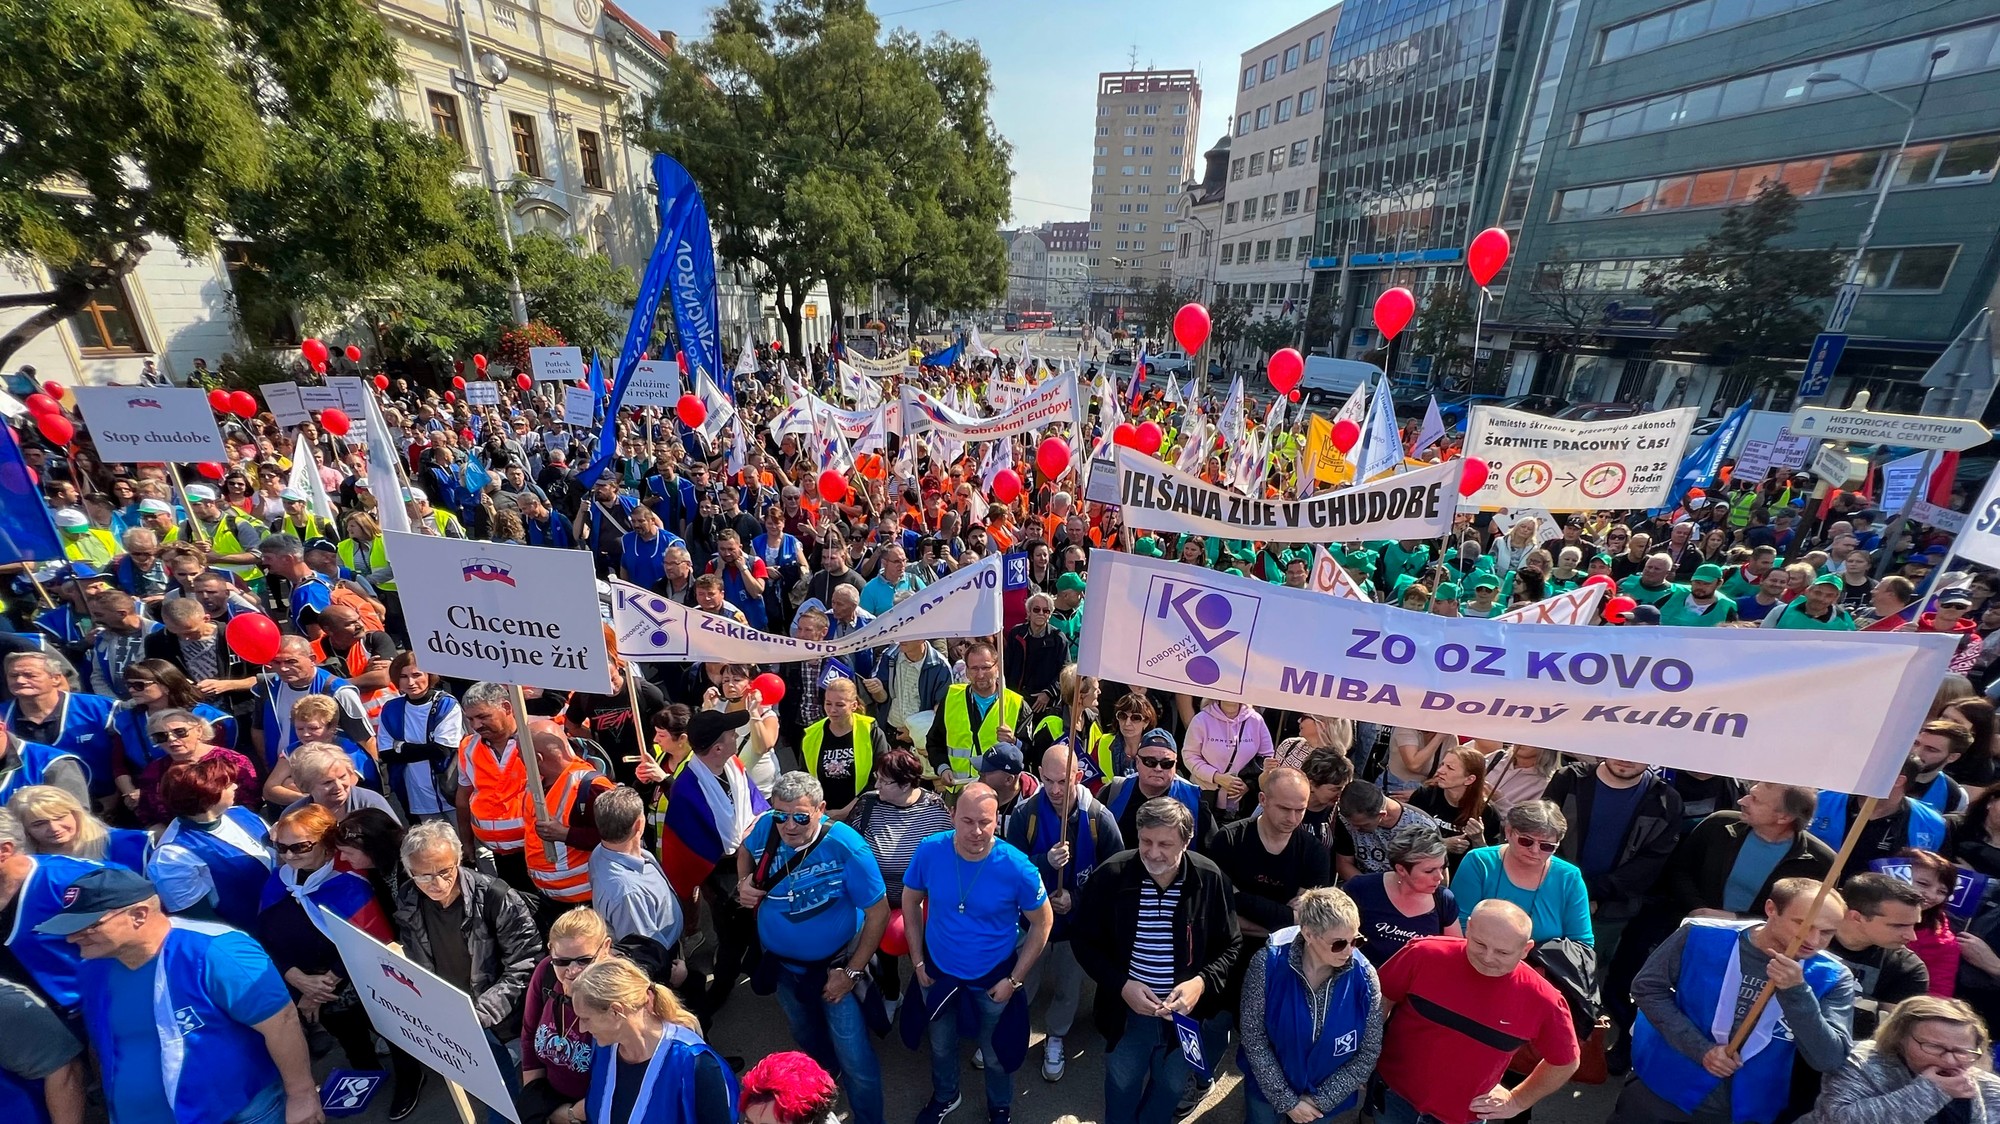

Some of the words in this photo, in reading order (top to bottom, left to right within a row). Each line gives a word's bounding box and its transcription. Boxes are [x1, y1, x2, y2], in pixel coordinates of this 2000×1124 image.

[626, 388, 633, 397] si
[636, 388, 669, 399] rešpekt
[963, 417, 1025, 436] žobrákmi
[1027, 398, 1073, 423] Európy!
[1488, 418, 1526, 429] Namiesto
[1529, 420, 1566, 432] škrtania
[1578, 424, 1628, 436] pracovných
[1631, 418, 1676, 430] zákonoch
[1830, 415, 1898, 428] HISTORICKÉ
[1902, 422, 1963, 434] CENTRUM
[102, 430, 140, 446] Stop
[144, 431, 211, 443] chudobe
[1484, 432, 1548, 449] ŠKRTNITE
[1553, 437, 1631, 451] PRACOVNÝ
[1636, 436, 1670, 450] ČAS!
[1825, 425, 1892, 438] HISTORICAL
[1896, 432, 1946, 444] CENTRE
[1652, 462, 1667, 471] 32
[1631, 473, 1663, 483] hodín
[1122, 470, 1222, 522] JELŠAVA
[1282, 502, 1301, 528] V
[1309, 482, 1443, 528] CHUDOBE
[447, 605, 561, 640] Chceme
[427, 630, 544, 669] dôstojne
[551, 645, 589, 671] žiť
[1146, 634, 1192, 668] ODBOROVÝ
[1346, 628, 1417, 665] ZO
[1434, 643, 1507, 677] OZ
[1527, 651, 1694, 693] KOVO
[1279, 666, 1402, 707] MIBA
[1420, 691, 1569, 724] Dolný
[1582, 704, 1749, 739] Kubín
[366, 984, 434, 1037] Zmrazte
[437, 1032, 479, 1067] ceny,
[399, 1026, 425, 1048] nie
